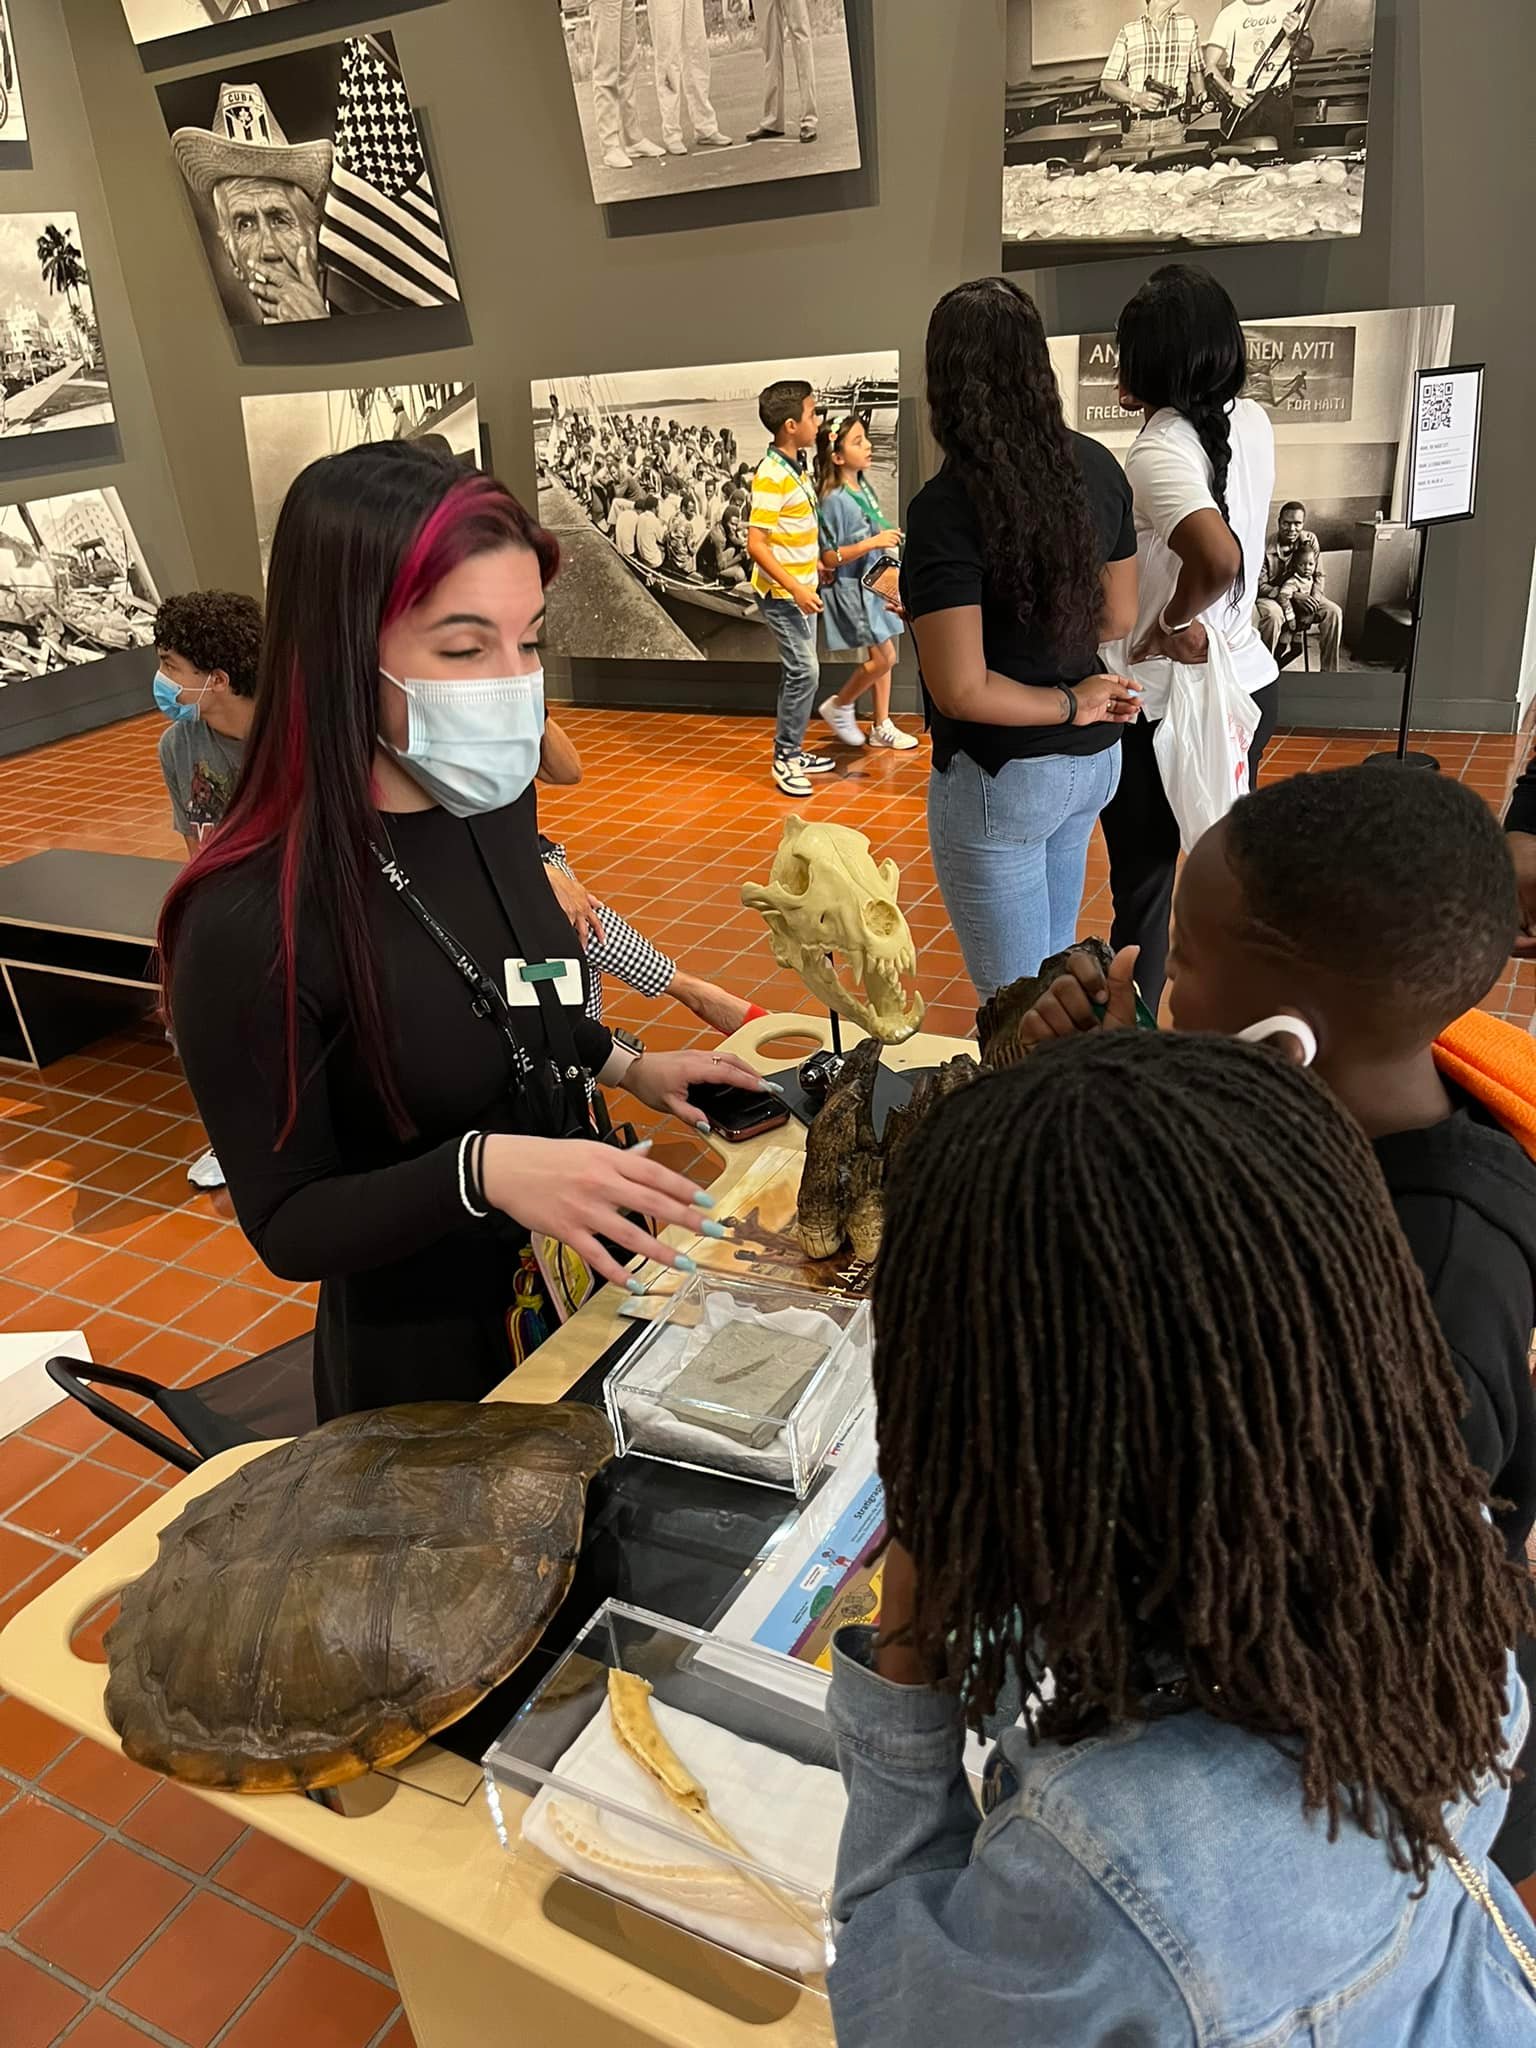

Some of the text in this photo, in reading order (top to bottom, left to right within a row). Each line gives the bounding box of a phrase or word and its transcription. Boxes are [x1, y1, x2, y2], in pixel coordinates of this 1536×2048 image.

[228, 93, 255, 103] CUBA
[1245, 341, 1284, 360] NEN
[1291, 341, 1334, 360] AYITI
[1287, 399, 1311, 411] FOR
[1313, 397, 1345, 410] HAITI
